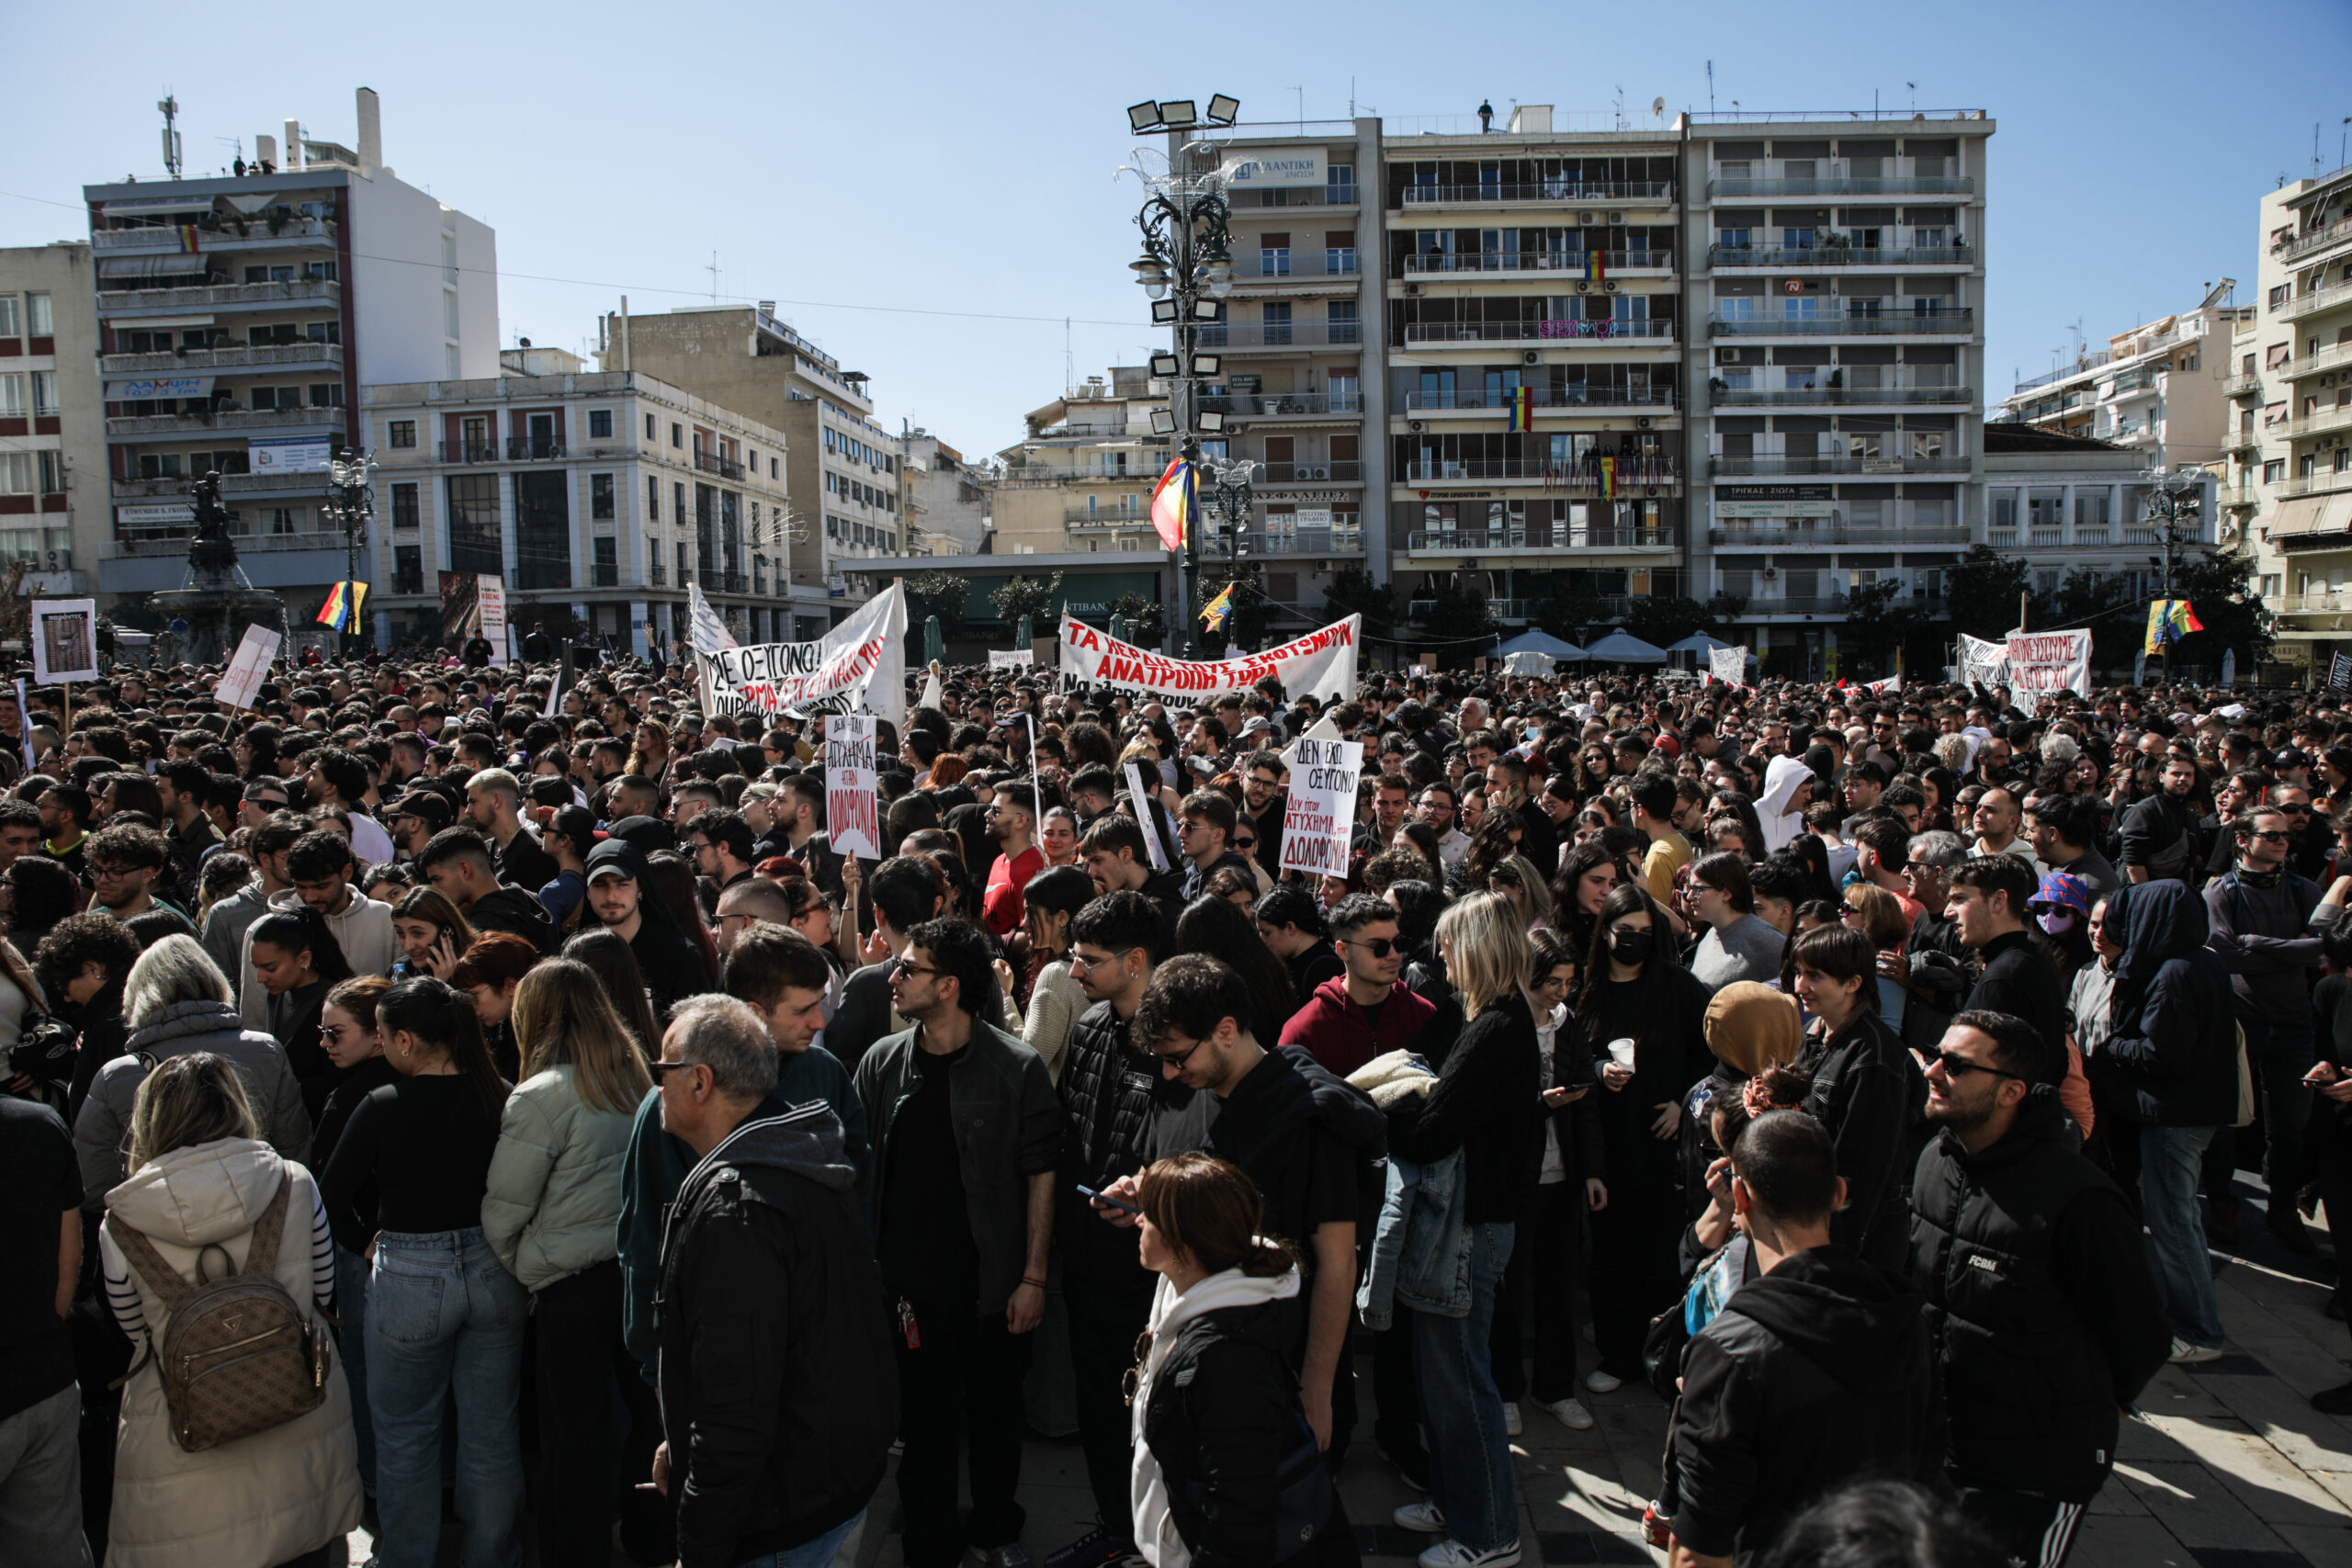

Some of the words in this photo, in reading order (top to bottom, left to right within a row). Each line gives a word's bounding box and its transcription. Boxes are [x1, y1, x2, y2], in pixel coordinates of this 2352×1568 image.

[1285, 170, 1315, 179] ΕΝΩΣΗ
[1540, 319, 1577, 337] SEX
[741, 641, 821, 681] ΟΞΥΓΟΝΟ!
[1069, 622, 1099, 651] ΤΑ
[1104, 637, 1173, 669] ΚΕΡΔΗ
[1176, 661, 1236, 674] ΤΟΥΣ
[1242, 621, 1352, 669] ΣΚΟΤΩΝΟΥΝ
[1096, 655, 1217, 690] ΑΝΑΤΡΟΠΗ
[1224, 663, 1280, 688] ΤΩΡΑ
[834, 718, 846, 734] ΔΕΝ
[828, 740, 875, 772] ΑΤΥΧΗΜΑ
[842, 770, 858, 786] ΗΤΑΝ
[1309, 768, 1355, 794] ΟΞΥΓΟΝΟ
[830, 790, 879, 855] ΔΟΛΟΦΟΝΙΑ
[1284, 835, 1346, 873] ΔΟΛΟΦΟΝΙΑ
